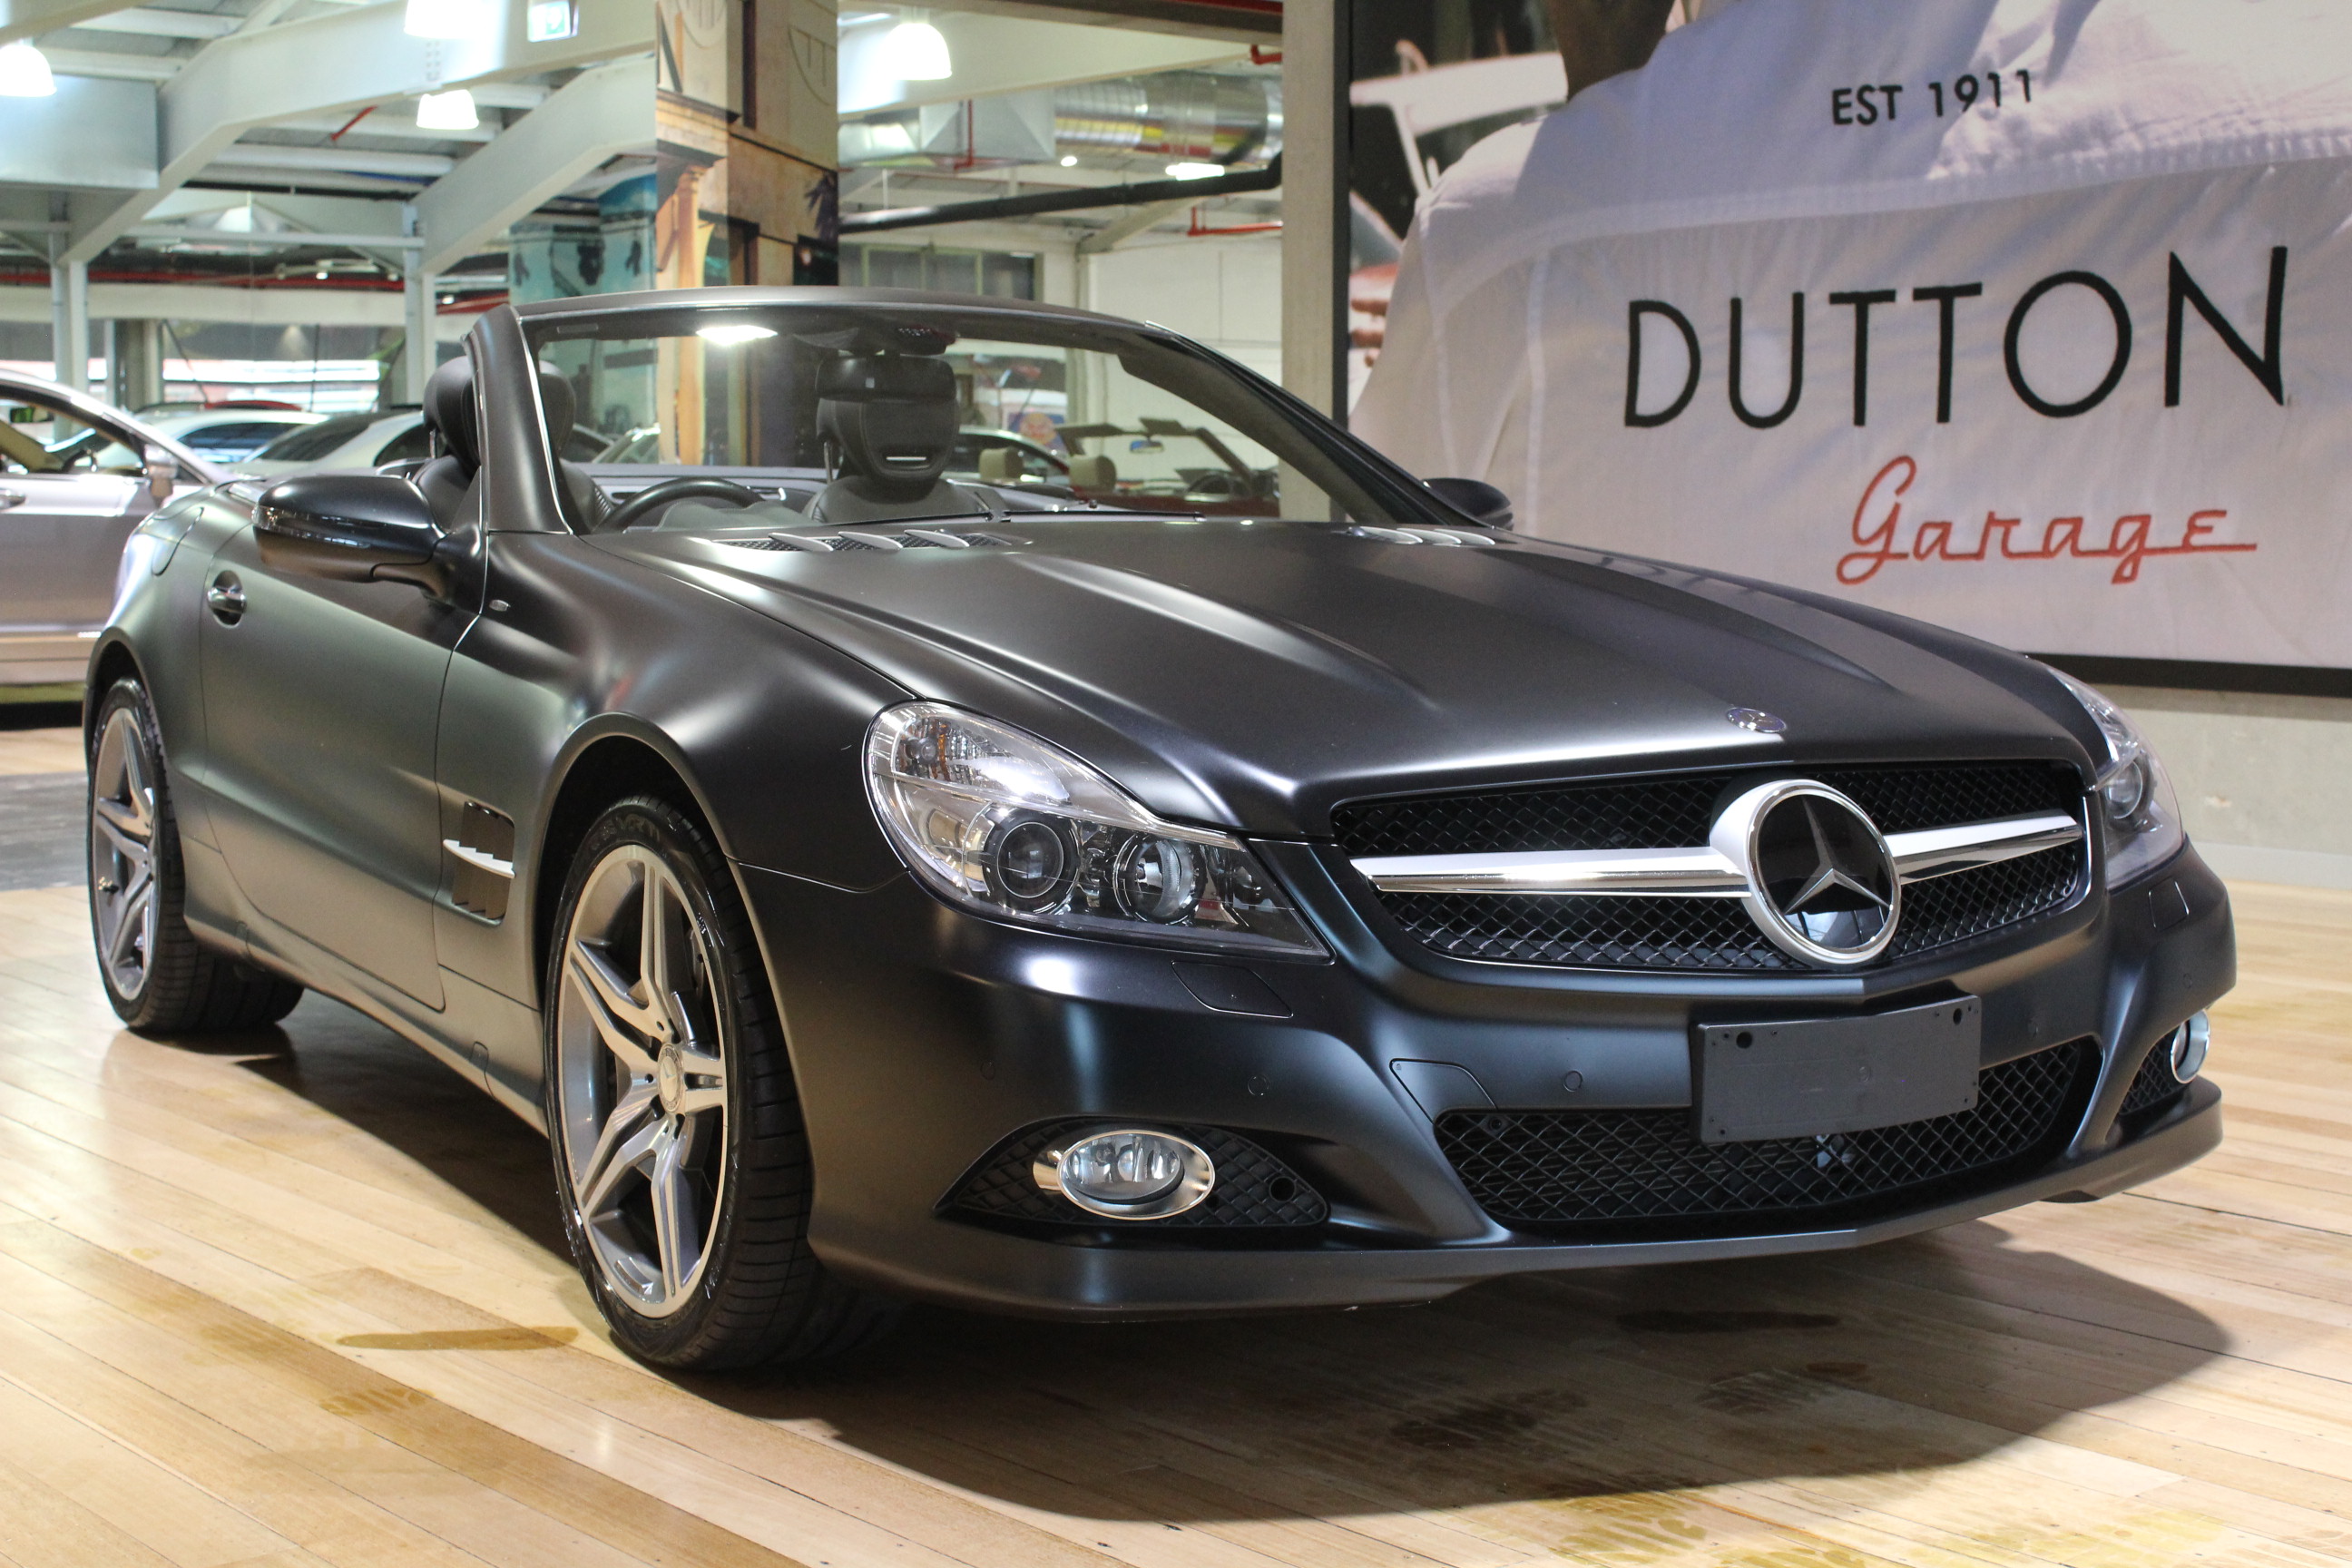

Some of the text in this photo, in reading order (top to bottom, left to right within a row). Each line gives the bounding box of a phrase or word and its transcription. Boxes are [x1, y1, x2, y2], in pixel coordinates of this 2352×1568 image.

[1831, 69, 2032, 125] EST 1911
[1624, 246, 2288, 428] DUTTON
[1836, 456, 2257, 585] Garage
